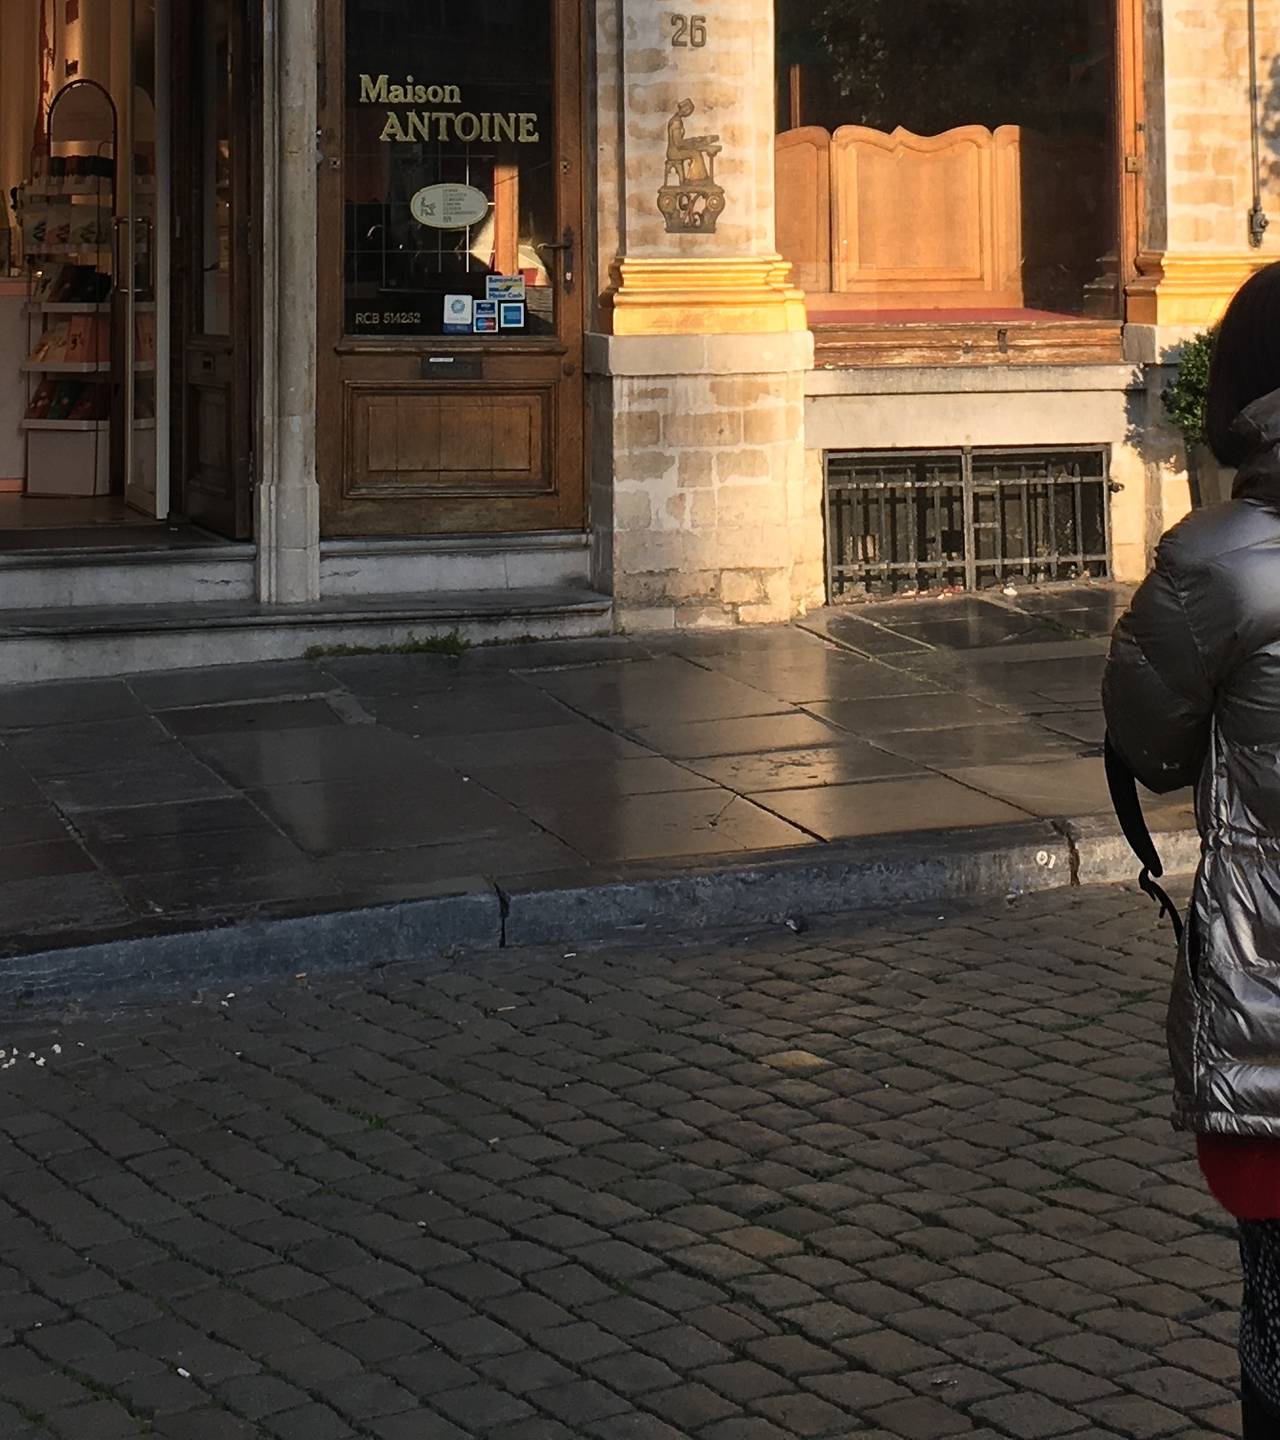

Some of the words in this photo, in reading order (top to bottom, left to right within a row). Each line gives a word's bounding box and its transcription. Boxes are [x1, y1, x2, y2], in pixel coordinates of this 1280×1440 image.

[670, 13, 707, 48] 26
[359, 73, 462, 104] Maison
[378, 109, 540, 143] ANTOINE
[355, 311, 380, 325] RCB
